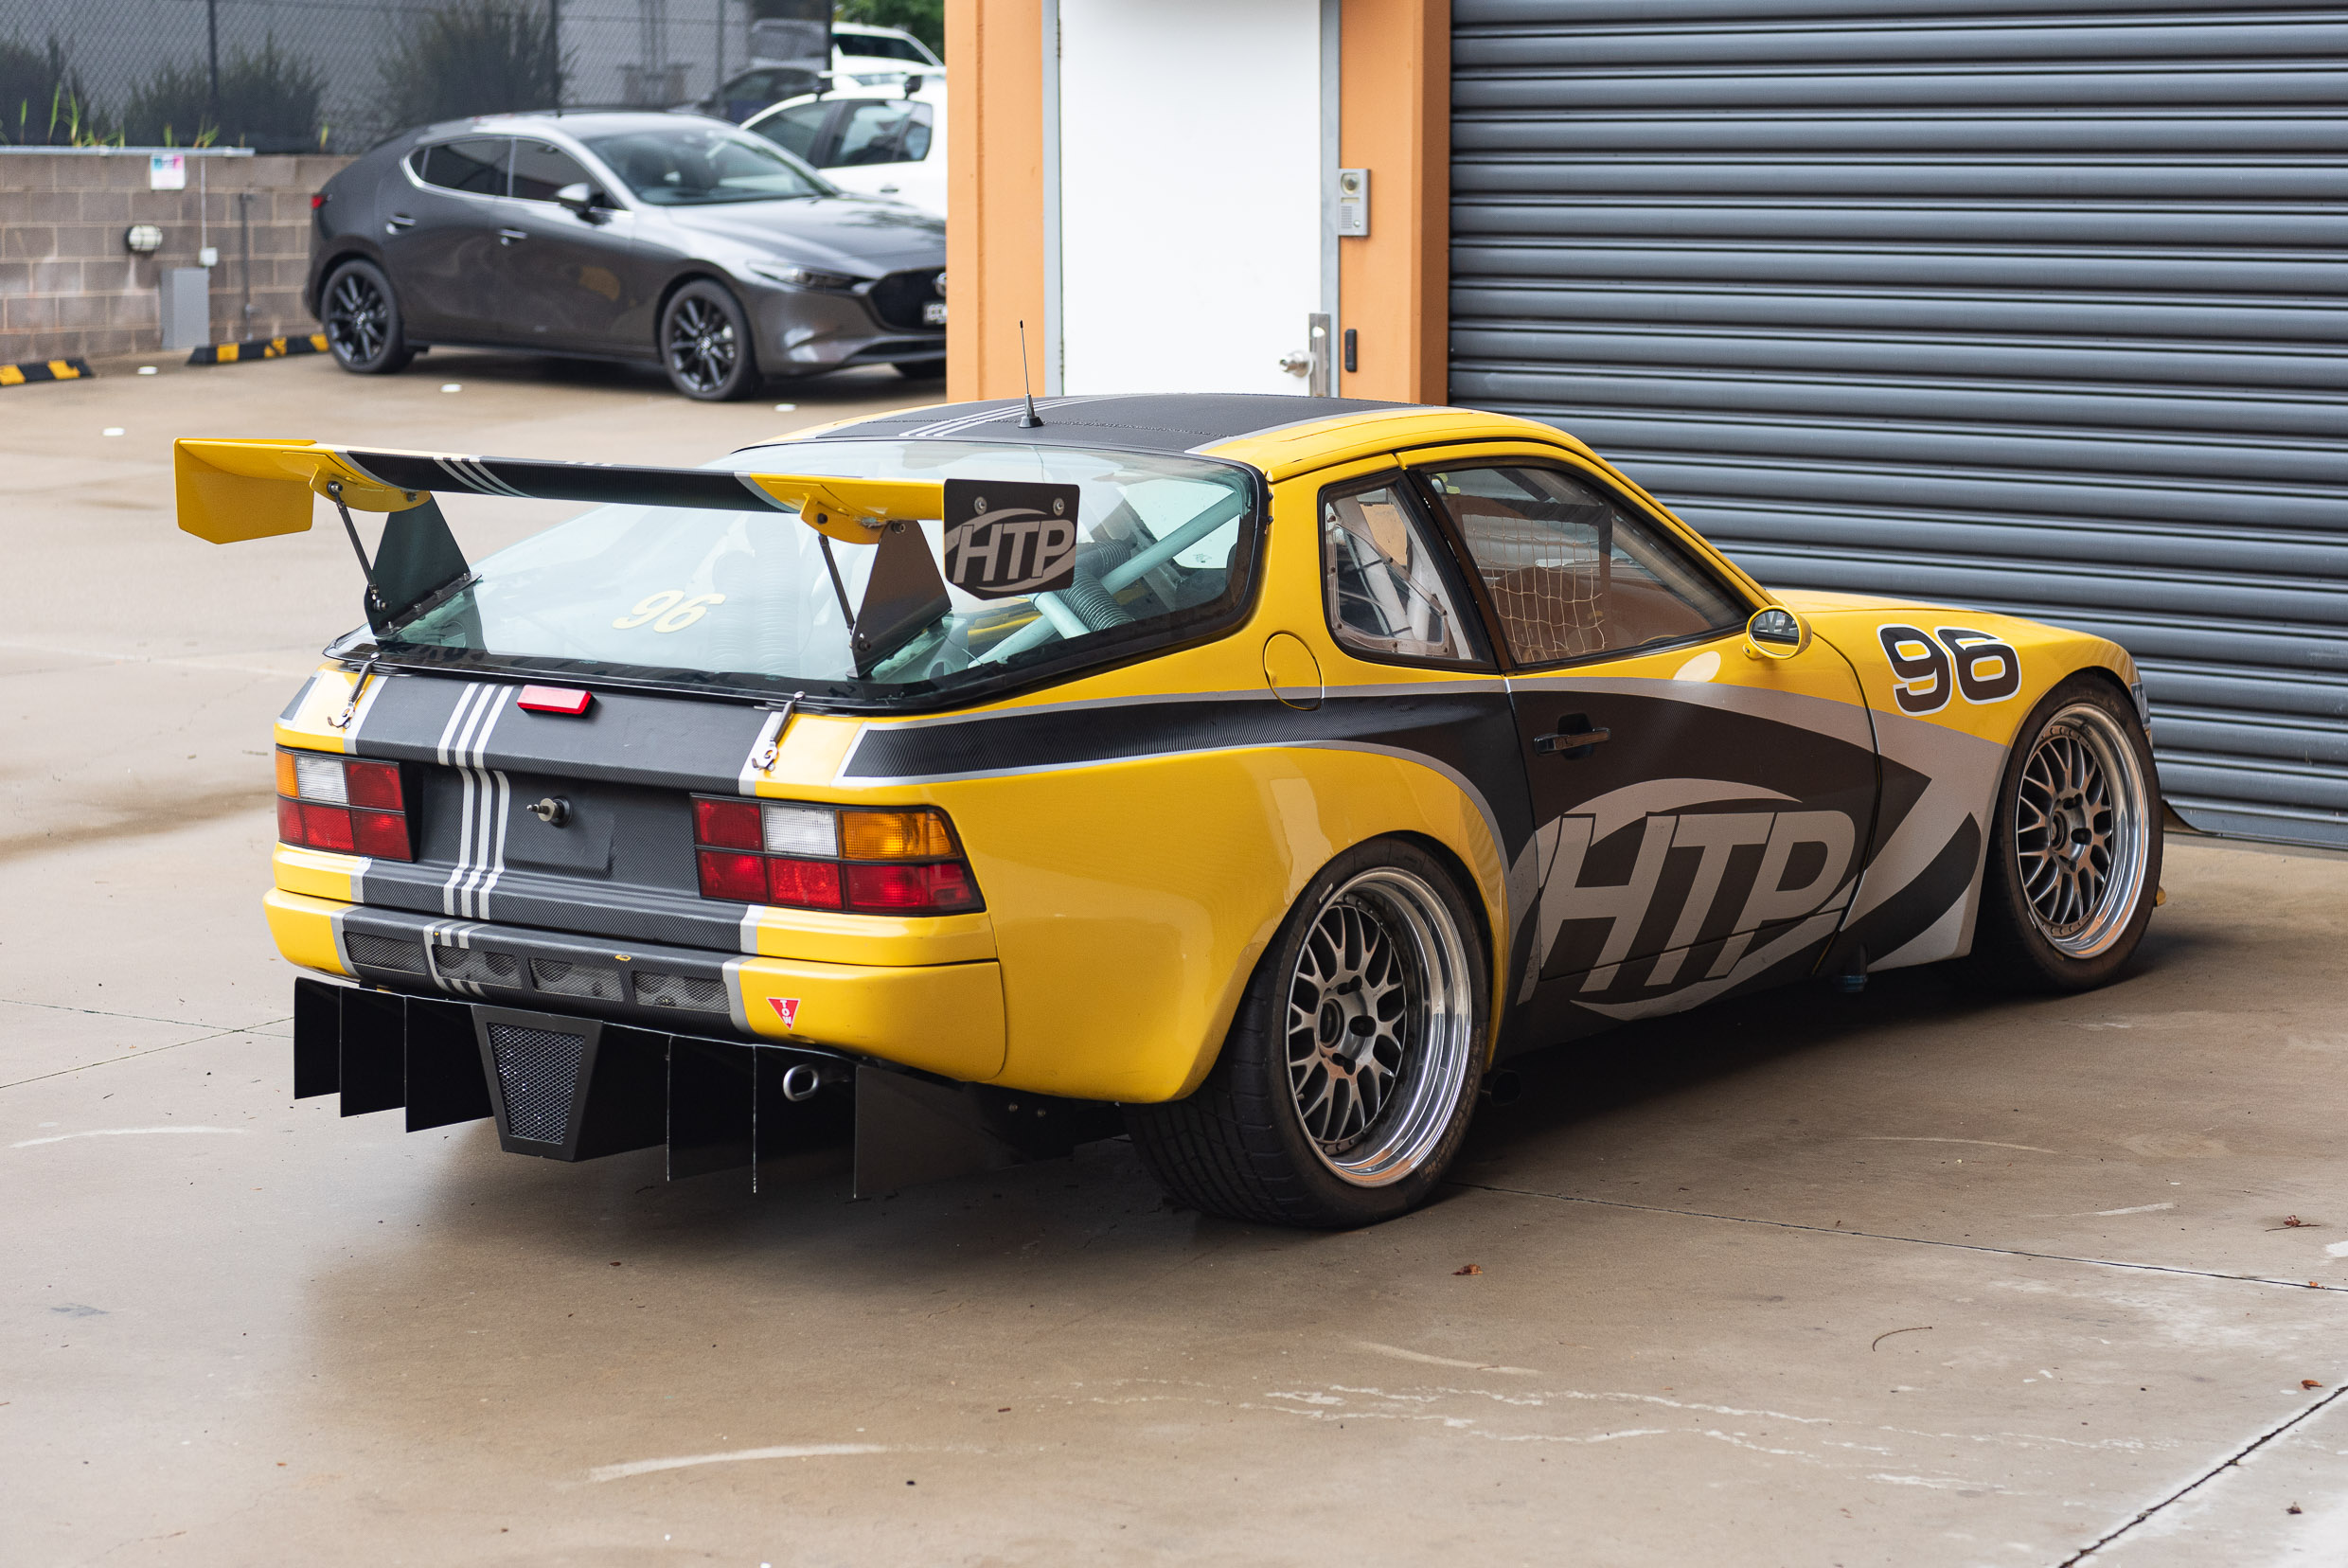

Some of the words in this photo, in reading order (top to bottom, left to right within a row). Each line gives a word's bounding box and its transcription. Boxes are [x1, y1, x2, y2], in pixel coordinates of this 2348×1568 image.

[952, 519, 1076, 584] HTP
[611, 589, 727, 634] 96
[1877, 623, 2022, 717] 96
[1515, 810, 1856, 1006] HTP
[779, 999, 792, 1025] TOW
